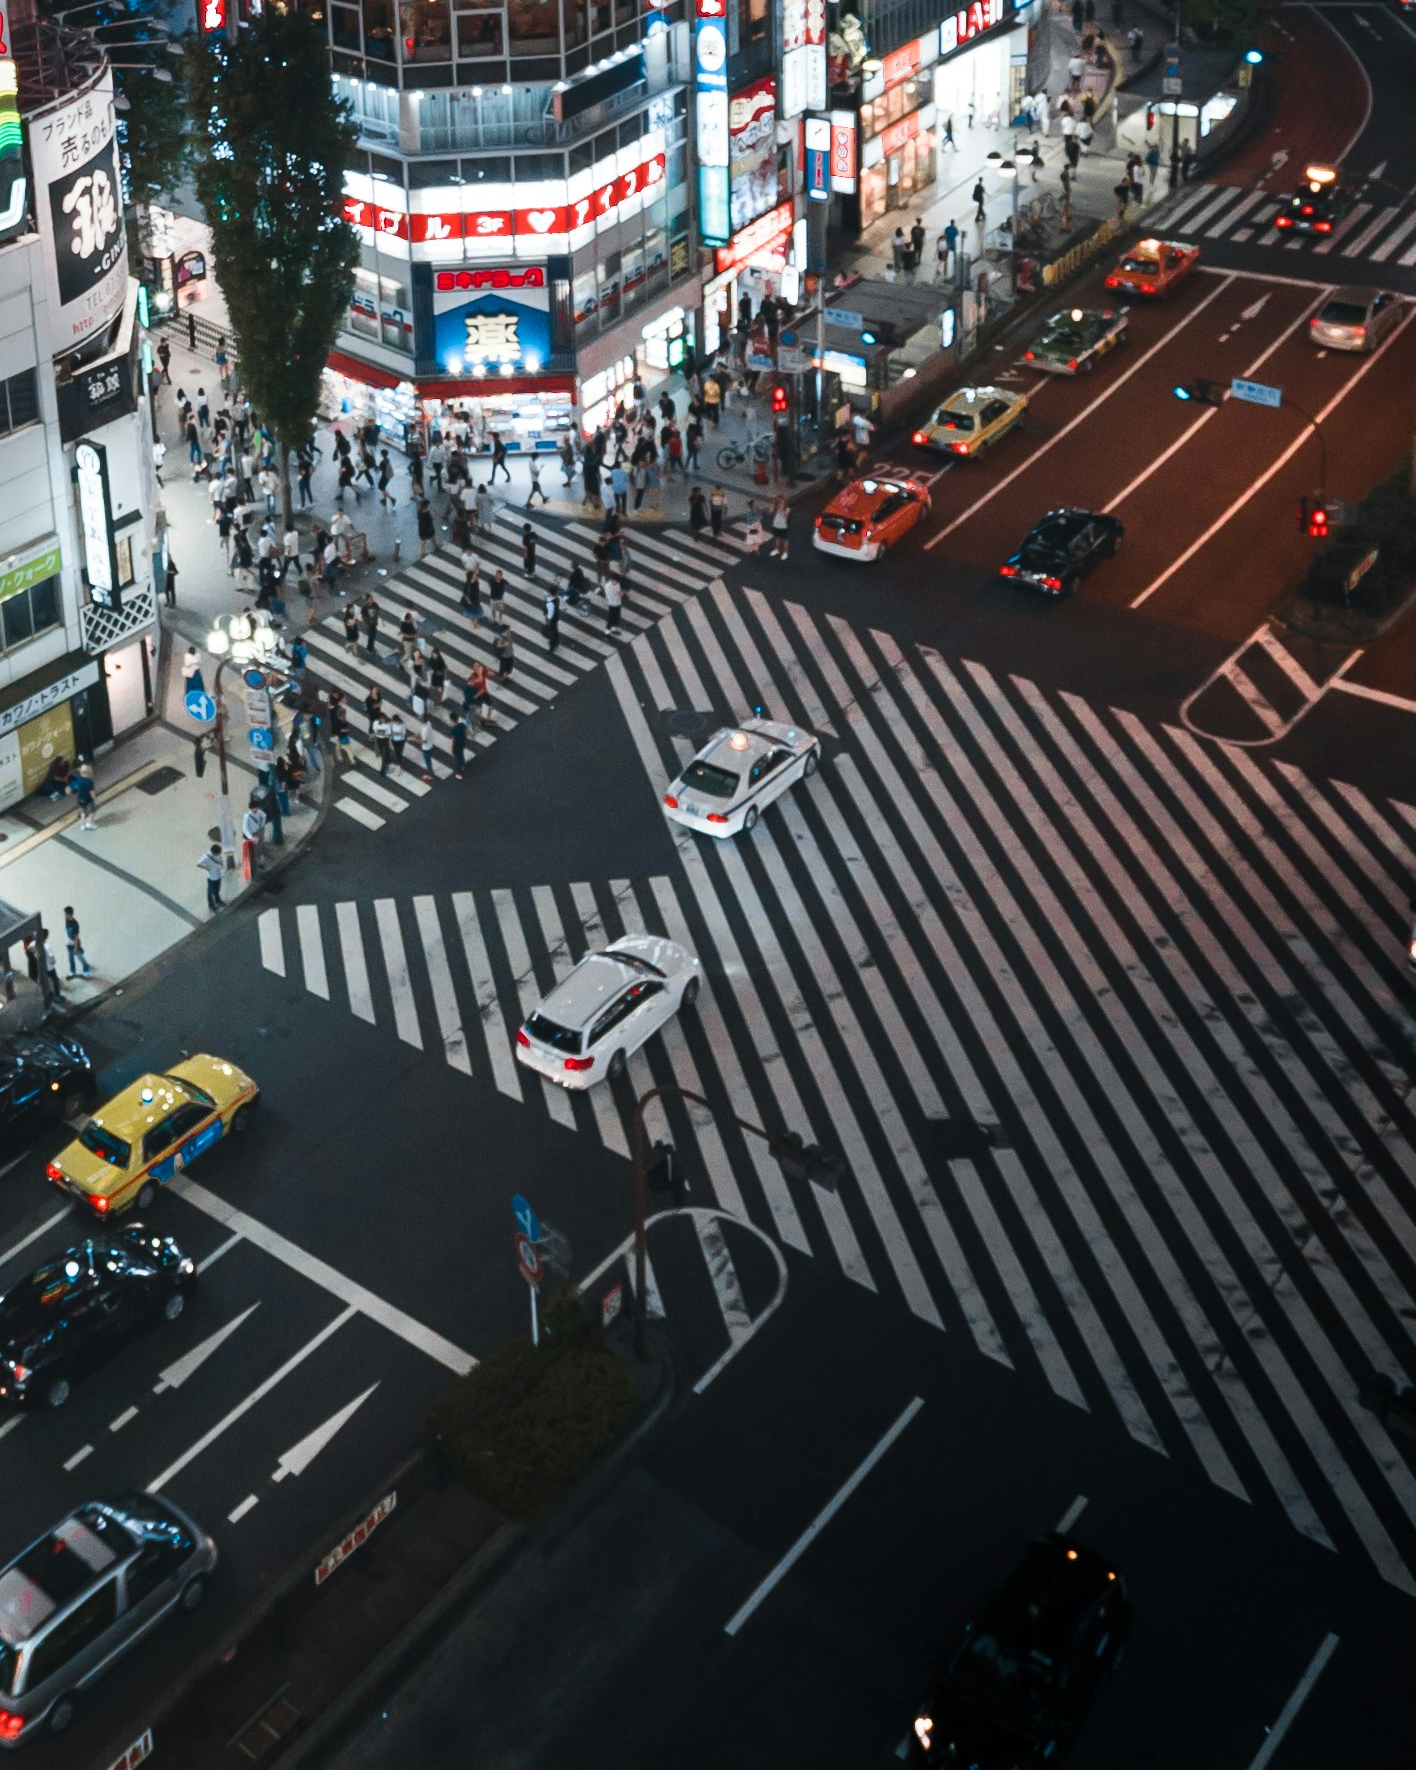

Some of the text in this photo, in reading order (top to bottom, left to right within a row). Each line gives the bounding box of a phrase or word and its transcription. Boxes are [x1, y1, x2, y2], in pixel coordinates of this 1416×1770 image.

[344, 201, 504, 240] イフル 3F
[464, 313, 521, 362] 薬
[1, 672, 80, 726] カワノ・トラスト
